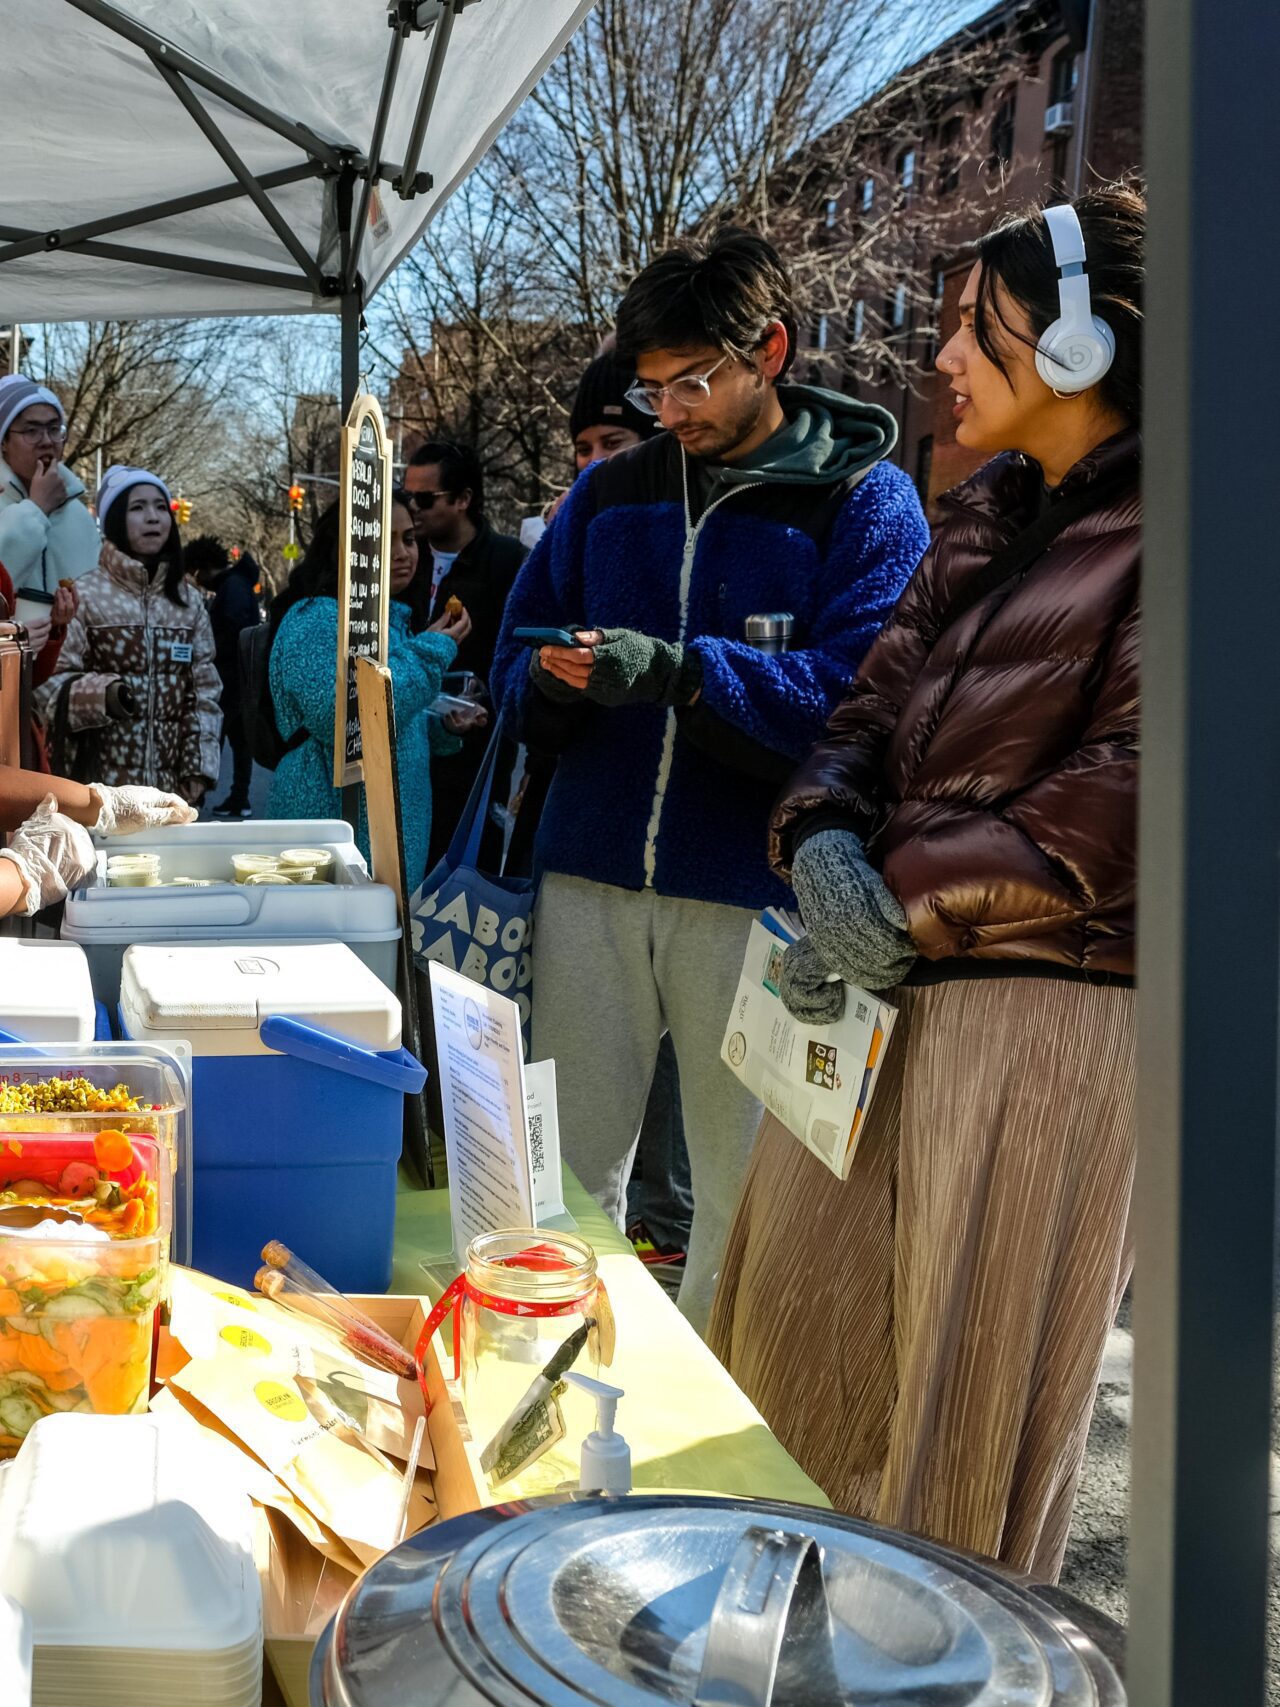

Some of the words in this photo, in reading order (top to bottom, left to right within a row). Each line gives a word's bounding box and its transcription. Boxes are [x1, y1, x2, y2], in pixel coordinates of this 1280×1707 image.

[360, 426, 374, 443] ENU
[353, 486, 370, 510] DOSA
[352, 515, 364, 541] AGI
